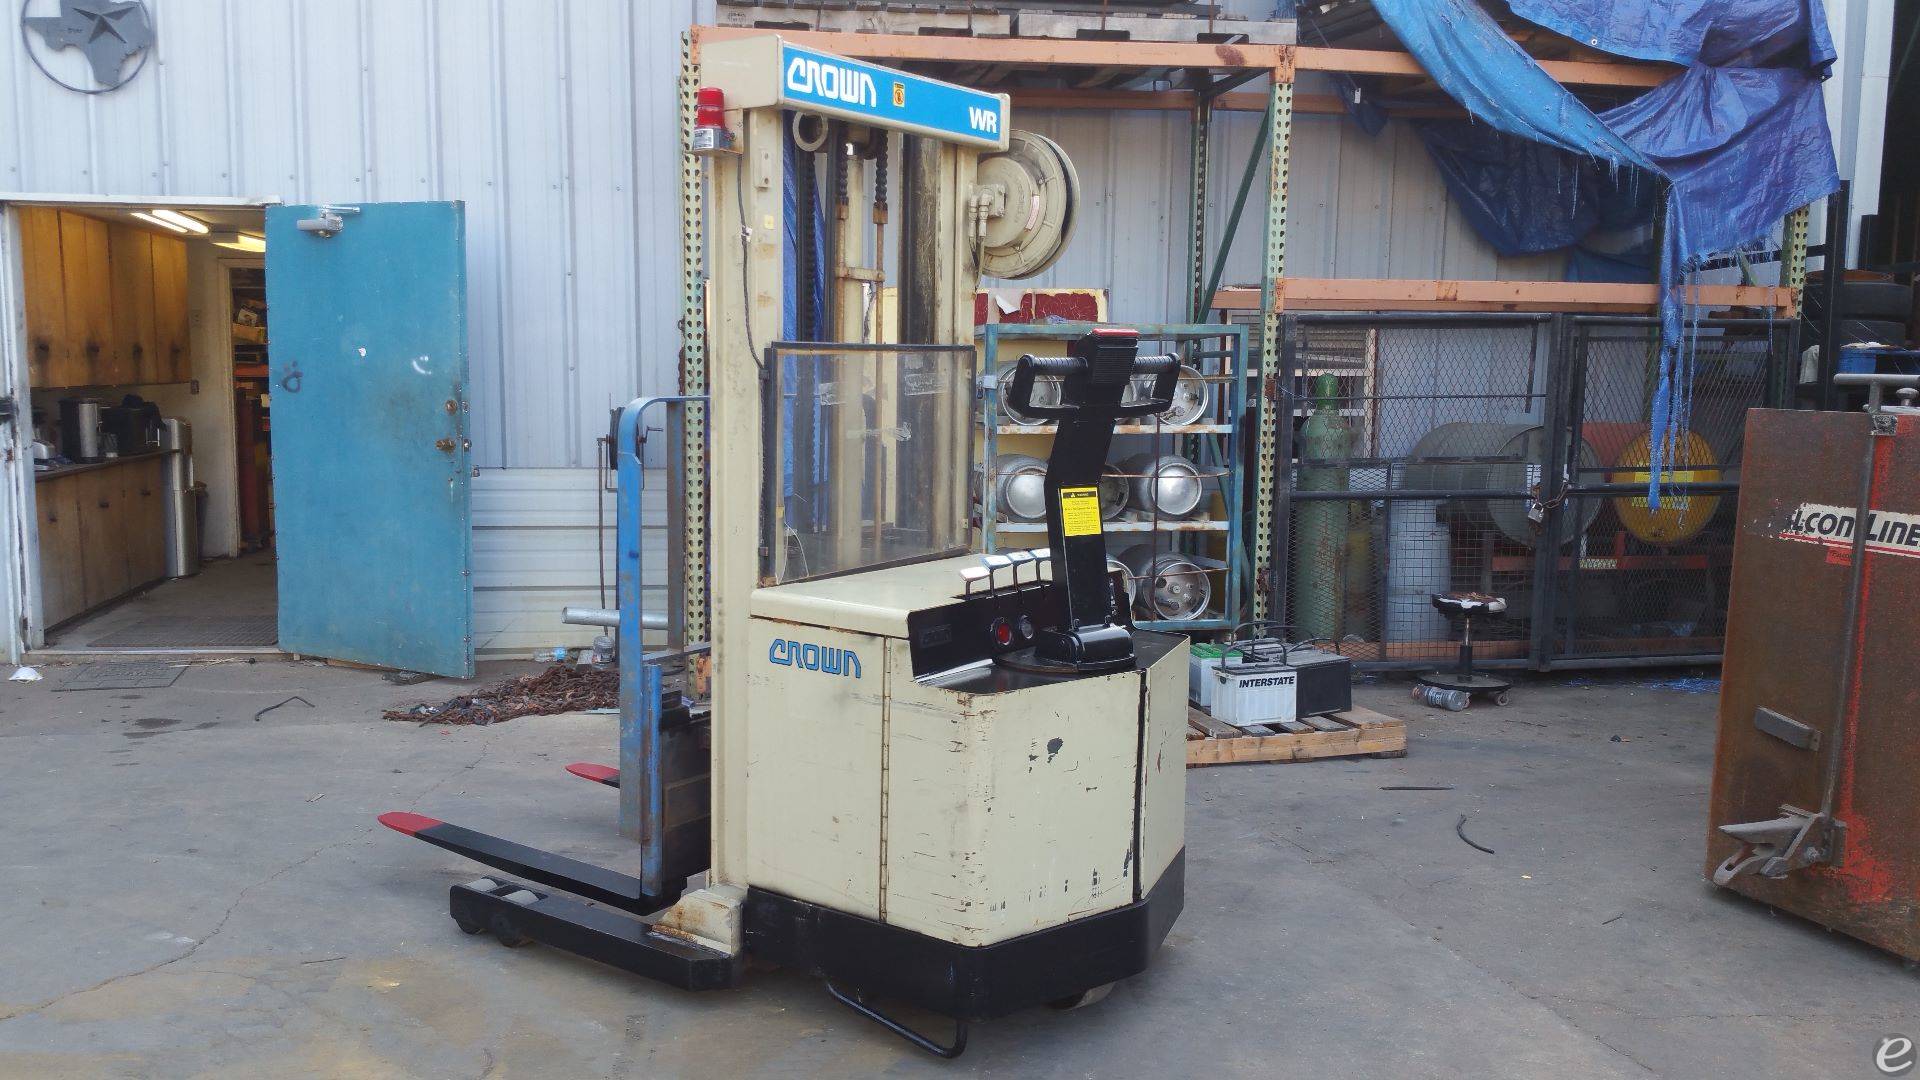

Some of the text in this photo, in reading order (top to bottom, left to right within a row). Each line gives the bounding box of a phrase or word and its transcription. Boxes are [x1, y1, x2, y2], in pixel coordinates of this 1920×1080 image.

[787, 57, 997, 133] CROWN WR
[769, 638, 861, 678] CROWN
[1239, 676, 1295, 688] INTERSTATE
